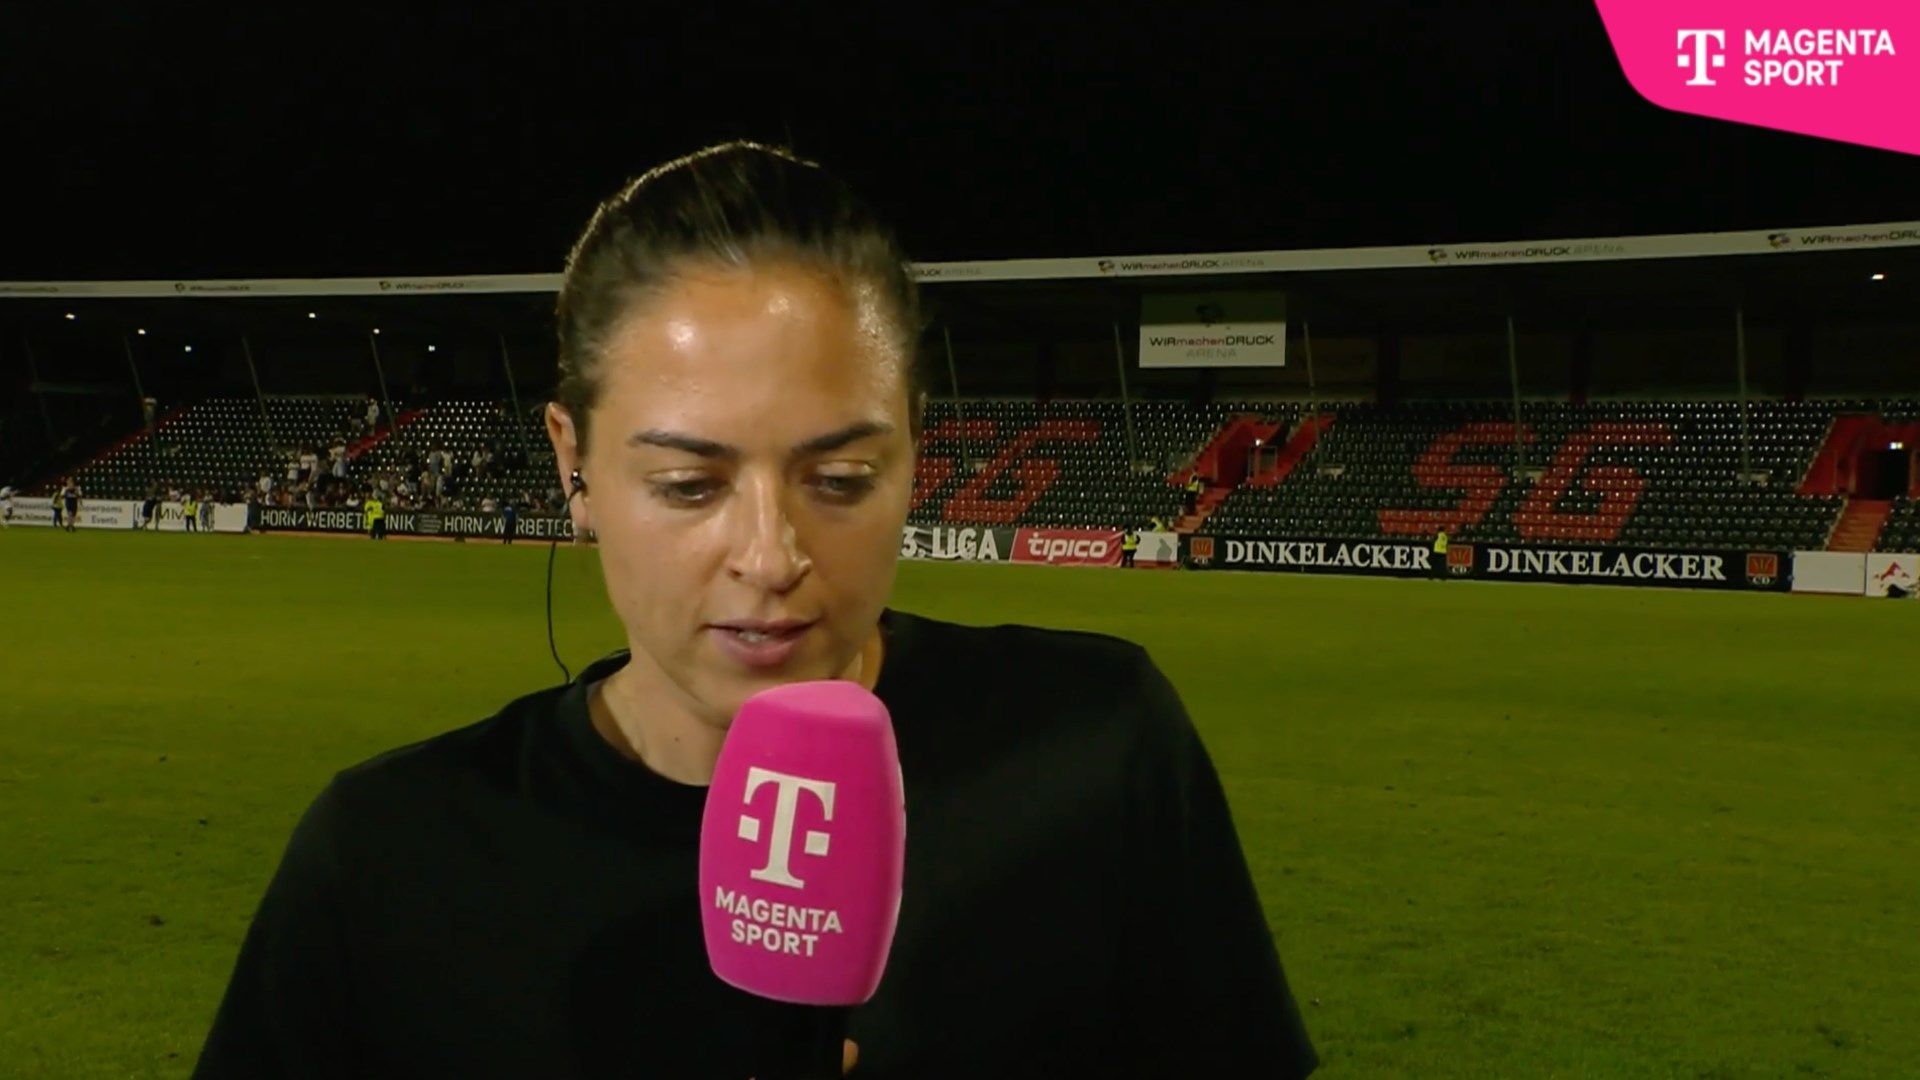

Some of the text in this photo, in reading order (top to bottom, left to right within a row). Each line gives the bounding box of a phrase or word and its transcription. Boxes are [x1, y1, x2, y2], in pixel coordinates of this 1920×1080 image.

[1149, 335, 1274, 346] WIRmachenDRUCK
[260, 509, 415, 531] HORN/WERBETNIK
[900, 526, 999, 560] 3. LIGA
[1027, 532, 1108, 561] tipico
[1225, 540, 1431, 570] DINKELACKER
[1487, 548, 1726, 580] DINKELACKER
[715, 886, 843, 933] MAGENTA
[731, 919, 818, 957] SPORT
